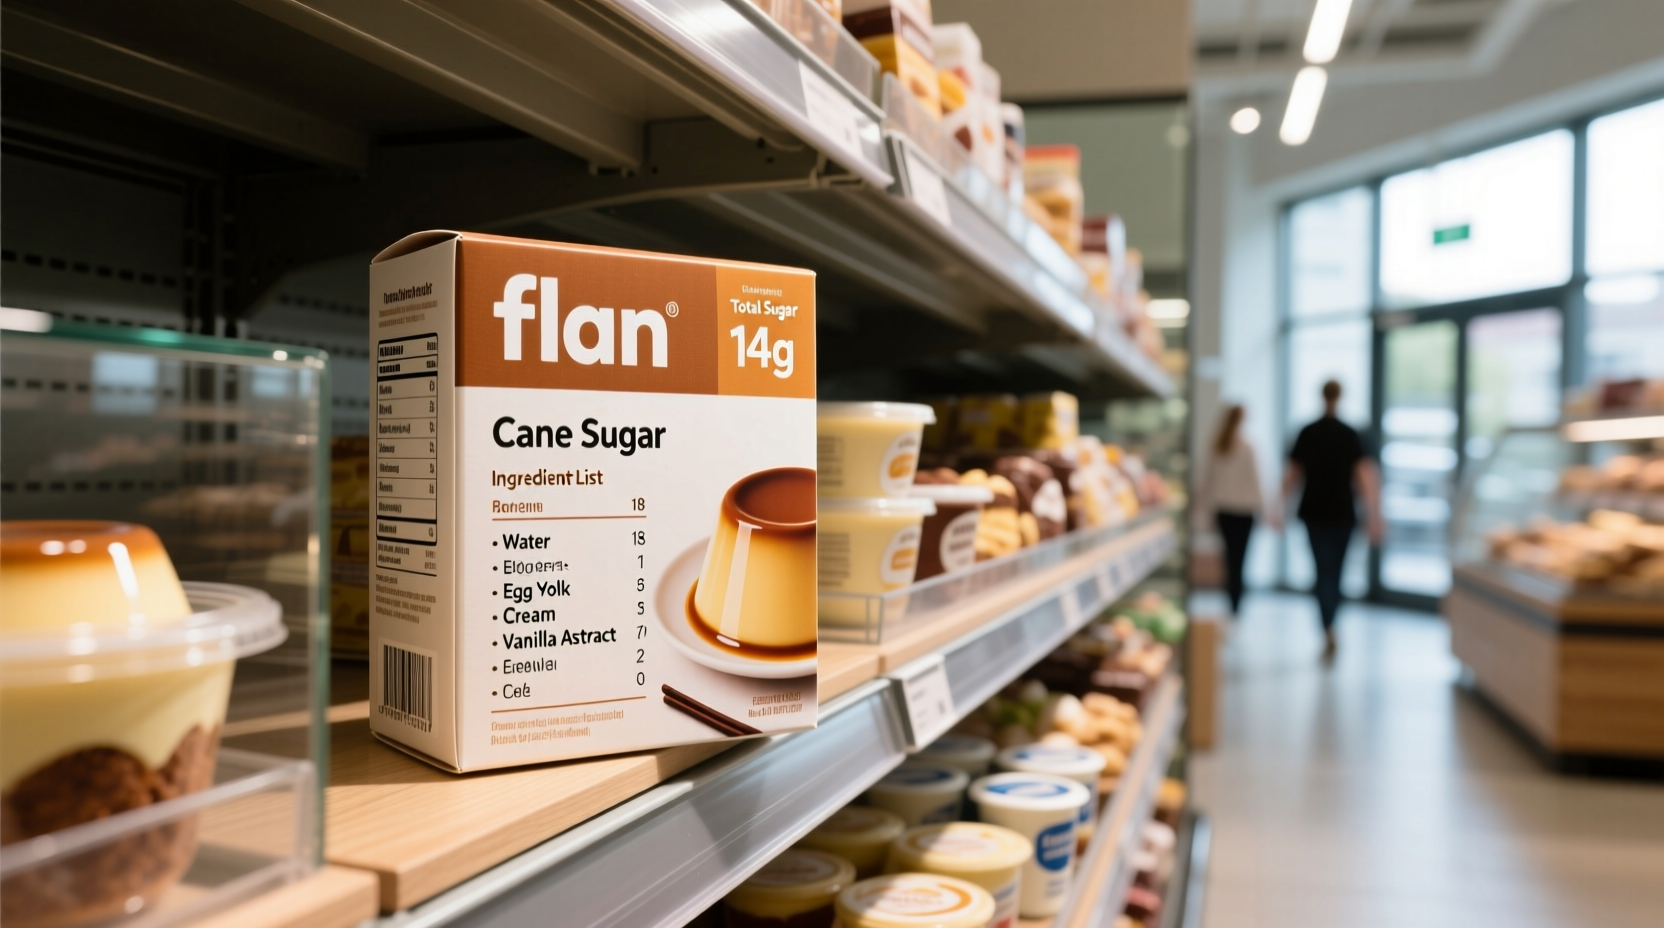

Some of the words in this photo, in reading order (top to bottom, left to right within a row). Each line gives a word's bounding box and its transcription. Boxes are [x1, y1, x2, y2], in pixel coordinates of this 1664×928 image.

[730, 298, 762, 315] Total
[764, 300, 799, 321] Sugar
[493, 273, 669, 369] flan
[730, 324, 794, 379] 14g
[492, 416, 573, 449] Cane
[581, 418, 667, 457] Sugar
[492, 469, 574, 491] Ingredient
[576, 469, 604, 486] List
[631, 497, 646, 512] 18
[502, 533, 551, 550] Water
[637, 554, 644, 569] 1
[503, 583, 533, 604] Egg
[536, 579, 571, 597] Yolk
[503, 606, 556, 625] Cream
[502, 629, 557, 650] Vanilla
[561, 627, 617, 646] Astract
[636, 648, 645, 664] 2
